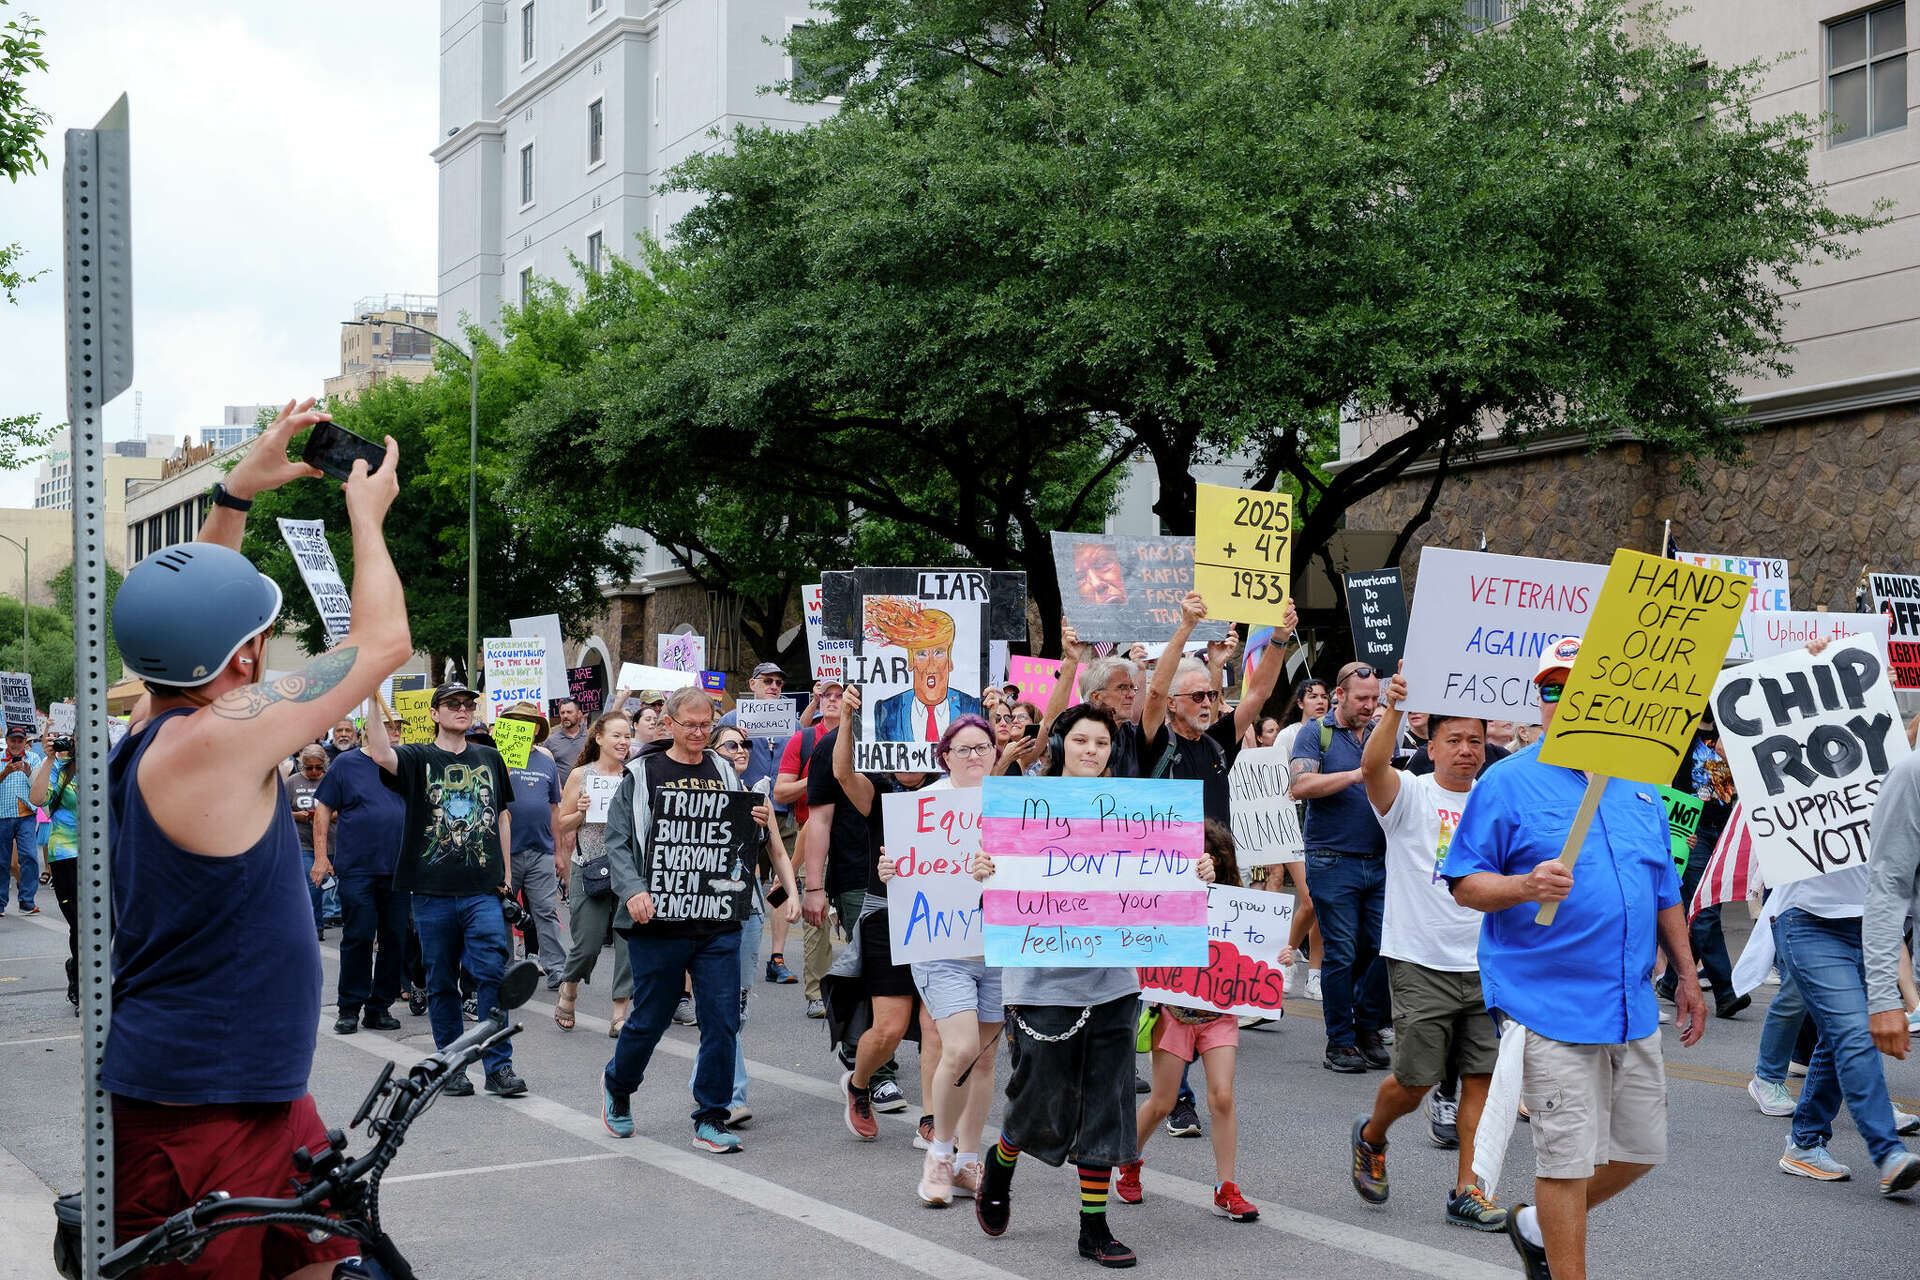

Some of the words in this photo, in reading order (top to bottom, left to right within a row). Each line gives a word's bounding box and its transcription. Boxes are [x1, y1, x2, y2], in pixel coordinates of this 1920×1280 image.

[1234, 497, 1290, 533] 2025
[1255, 533, 1288, 563] 47
[919, 573, 989, 602] LIAR
[1231, 571, 1284, 605] 1933
[1348, 574, 1397, 588] Americans
[1628, 559, 1748, 610] HANDS
[1873, 575, 1920, 599] HANDS
[1364, 588, 1378, 601] Do
[1470, 575, 1590, 614] VETERANS
[1361, 601, 1380, 615] Not
[1364, 614, 1392, 628] Kneel
[1638, 601, 1708, 632] OFF
[1375, 628, 1387, 640] to
[1466, 626, 1581, 660] AGAIN
[1767, 619, 1818, 649] Uphold
[487, 648, 546, 660] ACCOUNTABILITY
[820, 654, 837, 665] The
[1367, 641, 1394, 656] Kings
[1623, 630, 1697, 666] OUR
[1888, 642, 1920, 664] LGBT
[508, 658, 522, 667] THE
[525, 658, 541, 666] LAW
[574, 667, 593, 681] ARE
[842, 656, 910, 685] LIAR
[9, 678, 28, 686] PEOPLE
[1590, 655, 1703, 697] SOCIAL
[1, 685, 29, 697] UNITED
[1716, 647, 1881, 738] CHIP
[414, 700, 430, 710] am
[741, 702, 793, 714] PROTECT
[1561, 690, 1702, 736] SECURITY
[495, 730, 510, 739] bad
[513, 734, 532, 742] even
[516, 725, 526, 733] so
[740, 718, 792, 730] DEMOCRACY
[857, 742, 910, 771] HAIR
[1751, 711, 1893, 797] ROY
[661, 790, 730, 819] TRUMP
[1021, 798, 1071, 841] My
[1091, 793, 1185, 840] Rights
[1668, 800, 1701, 829] NOT
[654, 819, 733, 845] BULLIES
[651, 845, 730, 873] EVERYONE
[1039, 845, 1132, 878] DON'T
[1138, 847, 1190, 876] END
[650, 870, 700, 894] EVEN
[651, 893, 733, 920] PENGUINS
[1016, 890, 1089, 916] Where
[1225, 898, 1266, 923] grow
[1020, 923, 1103, 958] Feelings
[1114, 926, 1169, 953] Begin
[1243, 925, 1266, 944] to
[1192, 944, 1284, 1008] Rights
